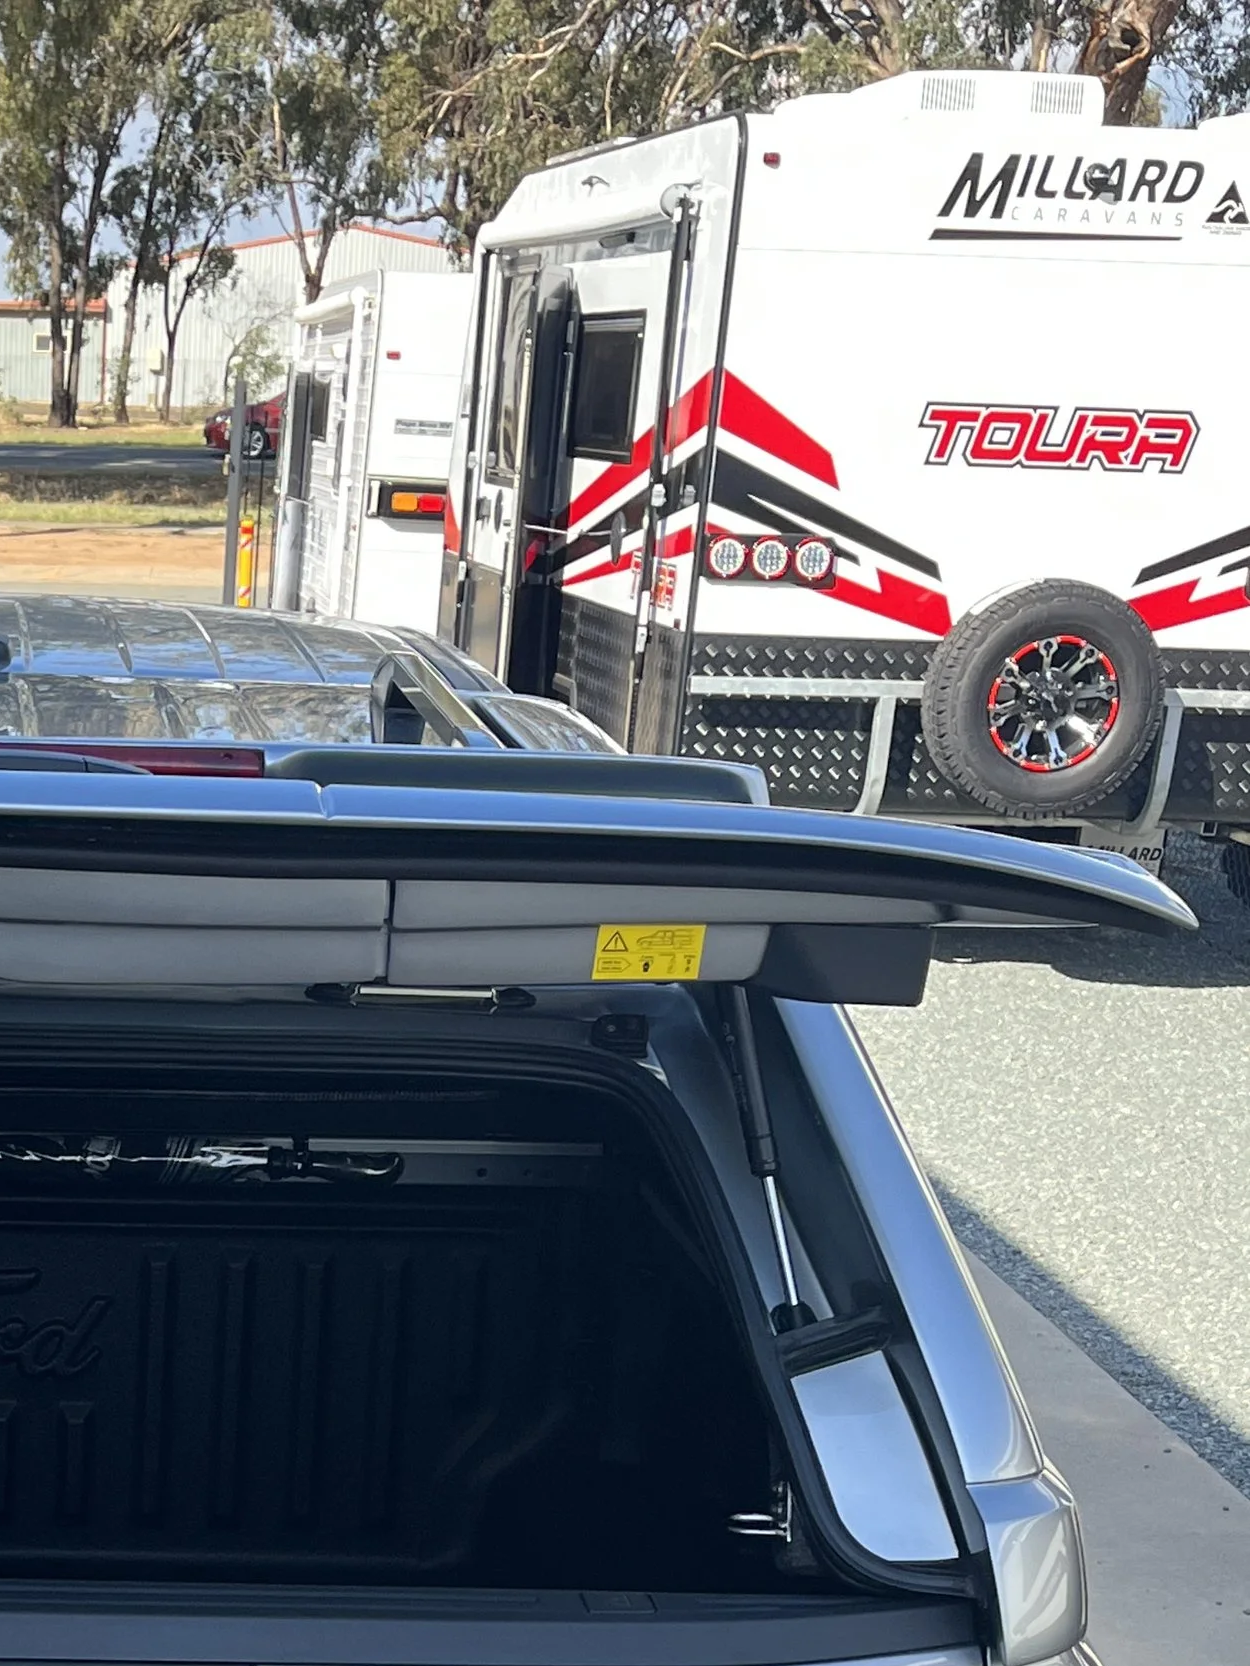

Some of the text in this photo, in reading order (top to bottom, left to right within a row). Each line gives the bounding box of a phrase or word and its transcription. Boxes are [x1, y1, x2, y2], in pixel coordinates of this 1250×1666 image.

[936, 152, 1205, 219] MILLARD
[1011, 205, 1184, 227] CARAVANS
[921, 402, 1200, 473] TOURA
